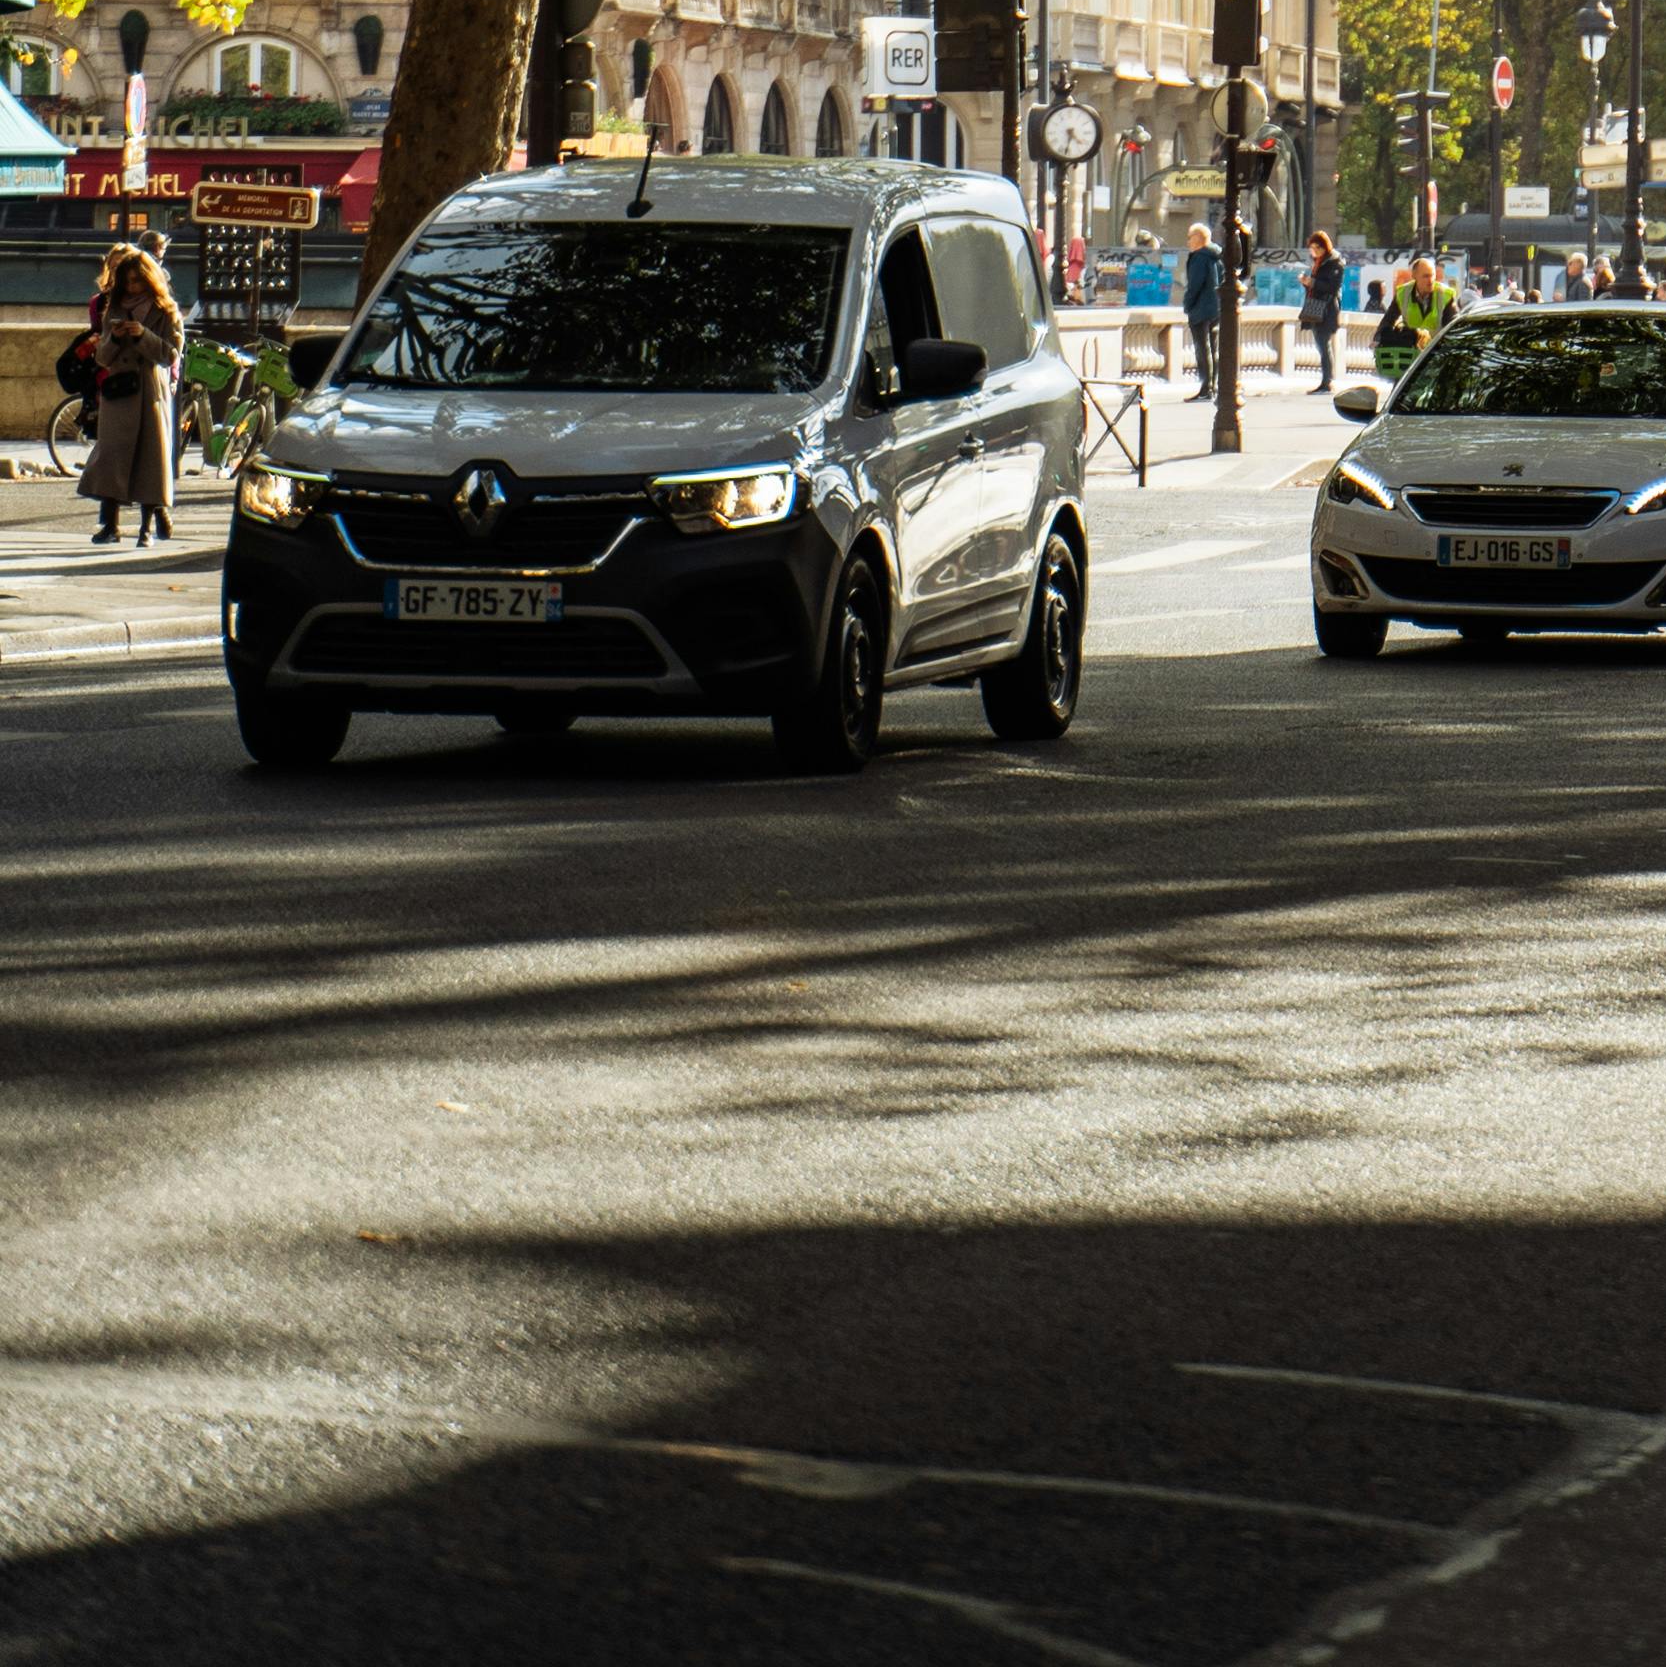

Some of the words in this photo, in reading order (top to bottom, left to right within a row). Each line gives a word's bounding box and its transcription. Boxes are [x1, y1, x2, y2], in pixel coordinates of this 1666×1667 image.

[891, 47, 924, 68] RER
[1454, 539, 1554, 563] EJ-016-GS
[404, 585, 543, 617] GF-785-ZY
